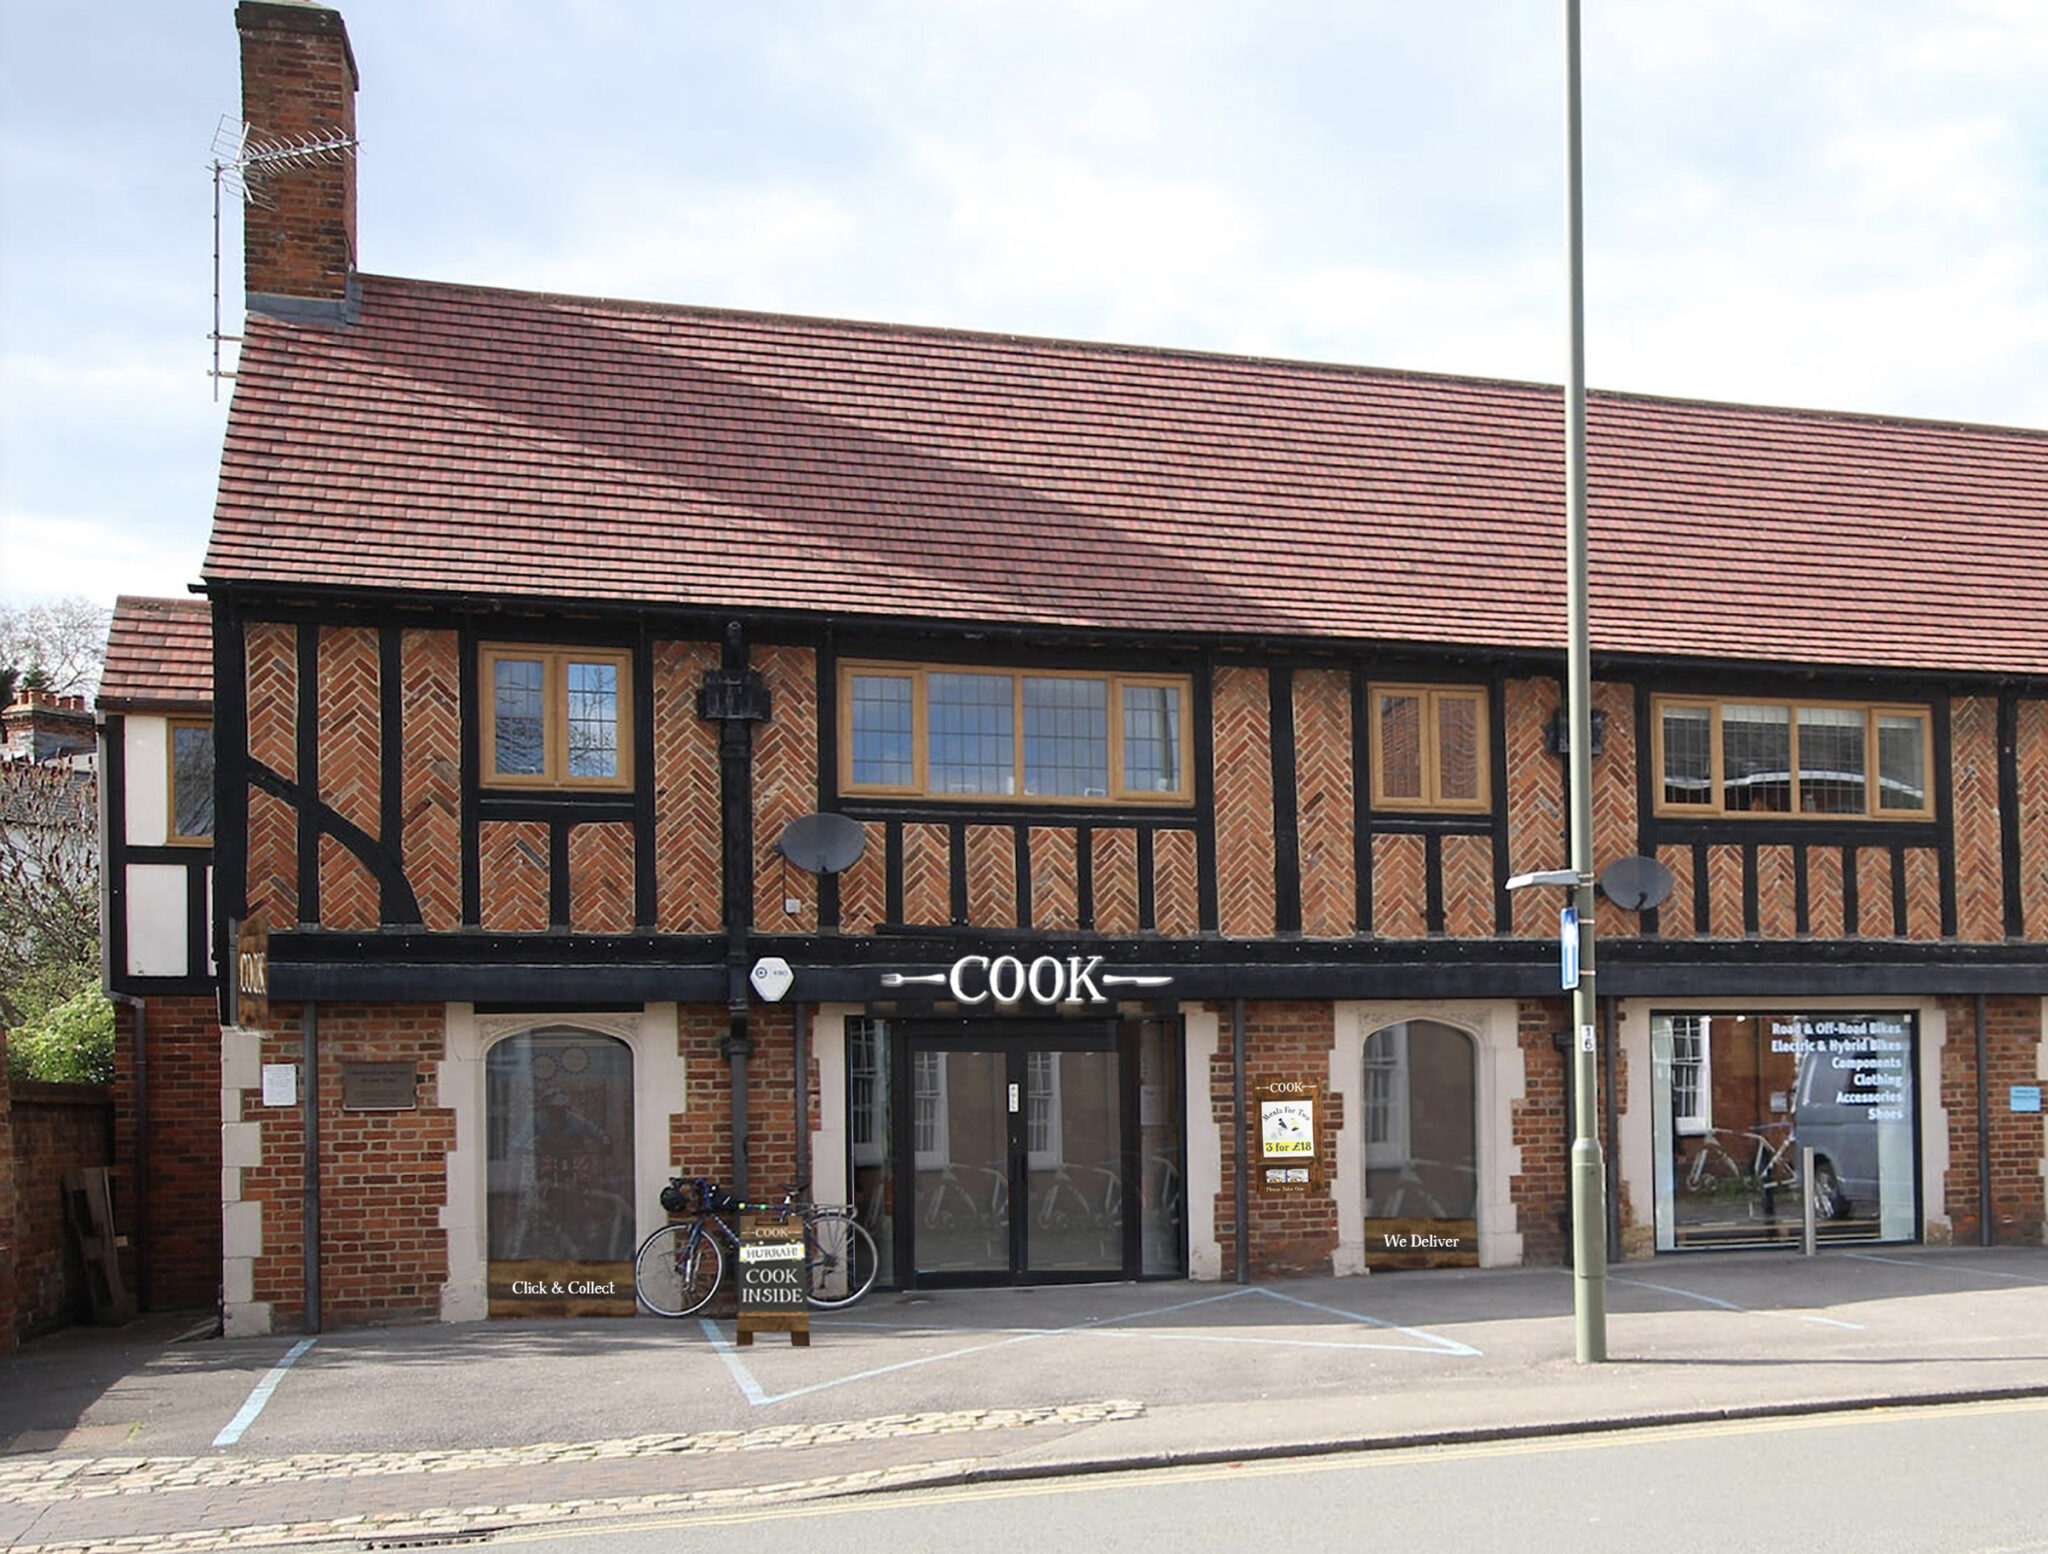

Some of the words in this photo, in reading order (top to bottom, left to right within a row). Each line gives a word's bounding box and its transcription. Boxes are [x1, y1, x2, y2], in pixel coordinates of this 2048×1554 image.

[949, 954, 1107, 1004] COOK
[1771, 1022, 1800, 1035] Road
[1803, 1022, 1814, 1035] &
[1816, 1021, 1867, 1035] Off-Road
[1870, 1022, 1902, 1034] Bikes
[1771, 1040, 1815, 1052] Electric
[1817, 1040, 1827, 1052] &
[1829, 1039, 1868, 1054] Hybrid
[1870, 1040, 1902, 1052] Bikes
[1832, 1057, 1902, 1071] Components
[1269, 1082, 1303, 1093] COOK
[1853, 1074, 1903, 1087] Clothing
[1835, 1091, 1903, 1103] Accessories
[1262, 1107, 1283, 1121] Meals
[1298, 1109, 1311, 1121] Two
[1867, 1108, 1904, 1120] Shoes
[1265, 1142, 1273, 1152] 3
[1275, 1142, 1290, 1152] for
[1292, 1141, 1312, 1152] £18
[755, 1228, 789, 1238] COOK
[1383, 1233, 1407, 1248] We
[1410, 1233, 1460, 1248] Deliver
[746, 1247, 798, 1259] HURRAH!
[745, 1268, 798, 1284] COOK
[511, 1281, 548, 1295] Click
[551, 1281, 565, 1295] &
[567, 1281, 616, 1295] Collect
[742, 1288, 803, 1303] INSIDE
